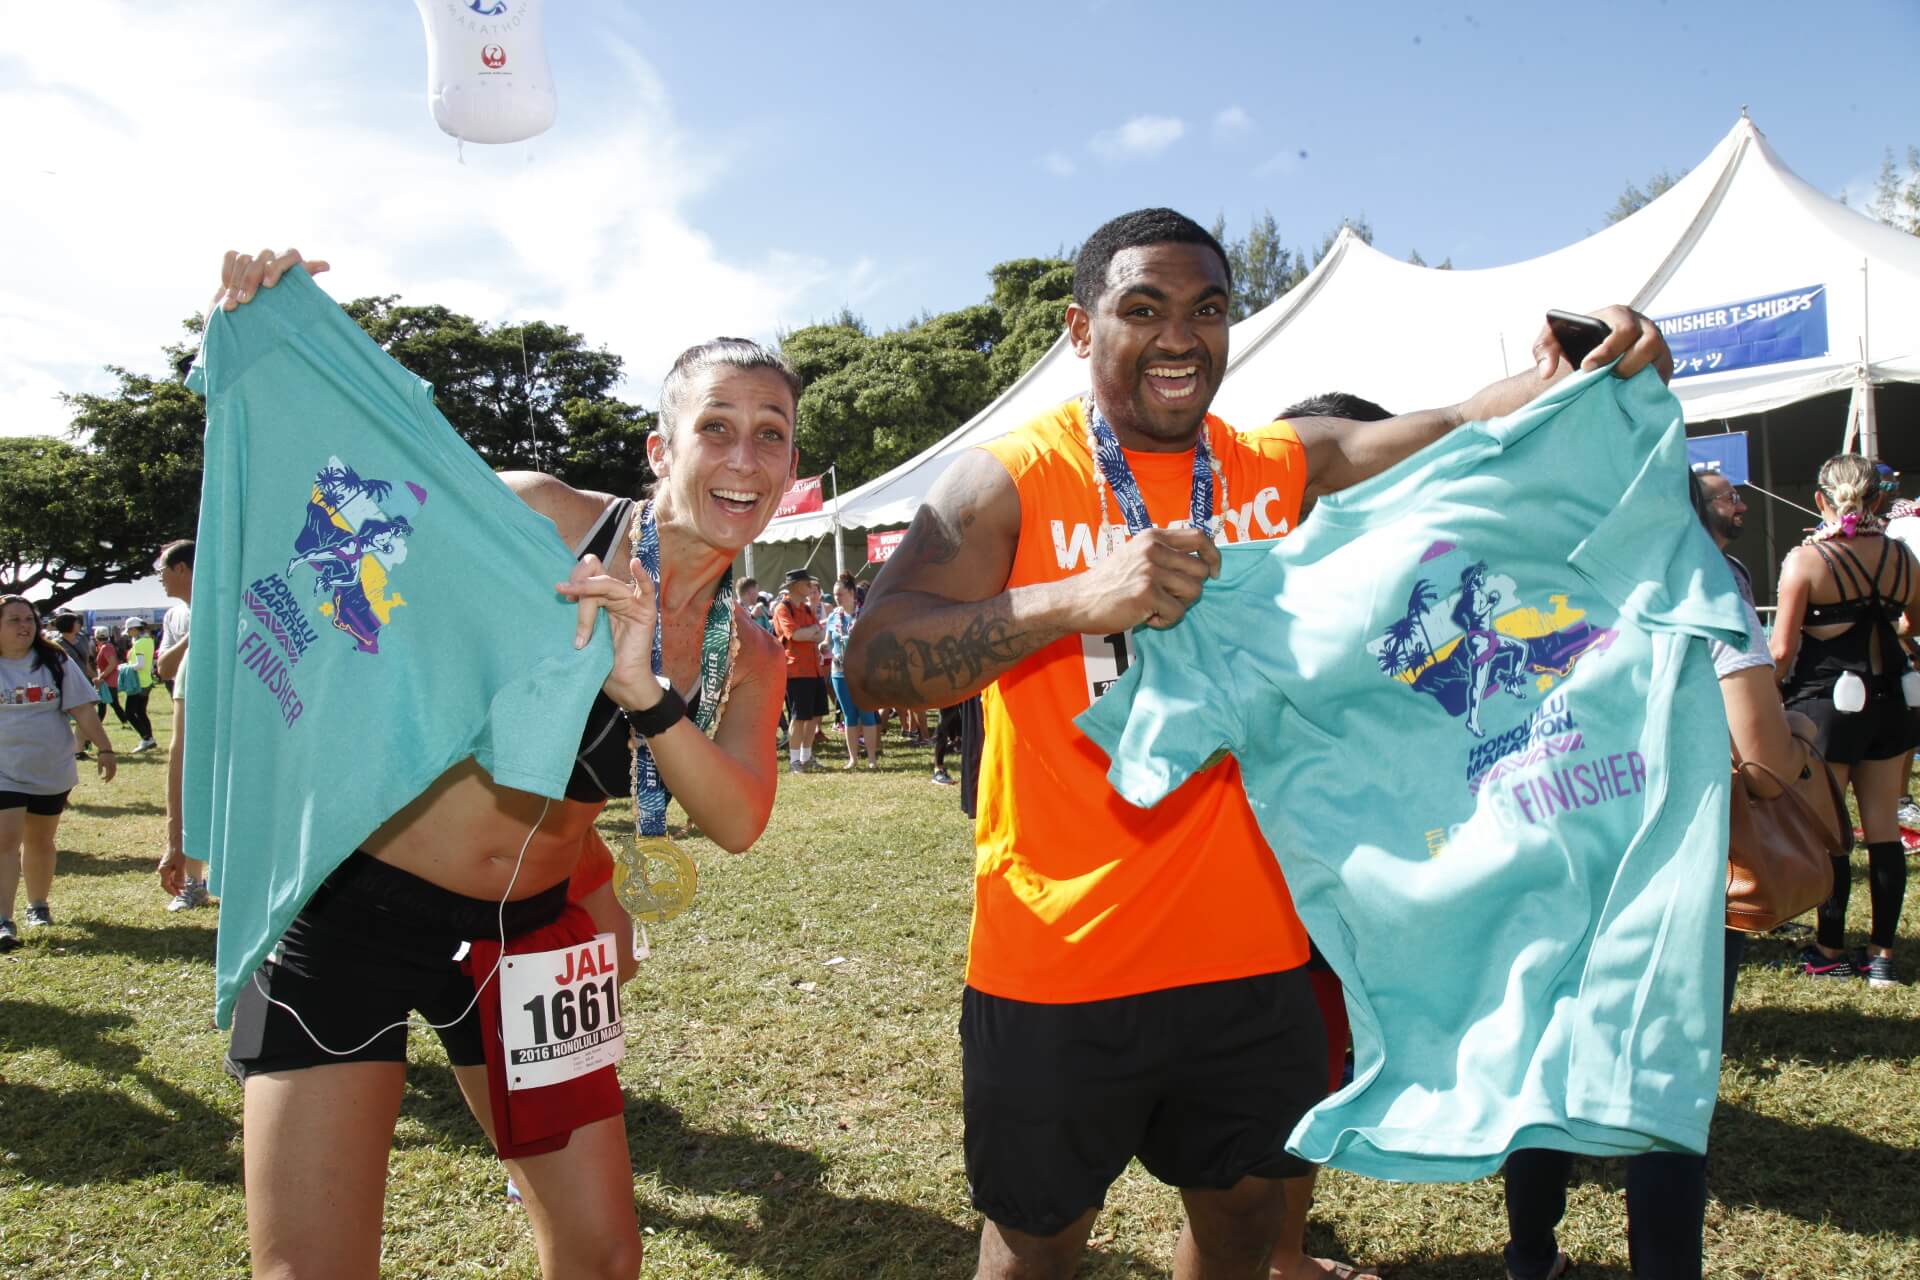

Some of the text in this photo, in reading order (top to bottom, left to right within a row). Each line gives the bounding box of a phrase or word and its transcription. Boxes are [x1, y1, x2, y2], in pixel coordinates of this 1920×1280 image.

[448, 2, 527, 34] MARATHON
[1730, 293, 1812, 324] T-SHIRTS
[1195, 481, 1206, 529] INISHER
[266, 573, 318, 644] HONOLULU
[238, 631, 304, 729] FINISHER
[1512, 751, 1647, 824] FINISHER
[555, 943, 614, 986] JAL
[523, 976, 615, 1045] 1661
[519, 1023, 622, 1063] 2016 HONOLULU MARA
